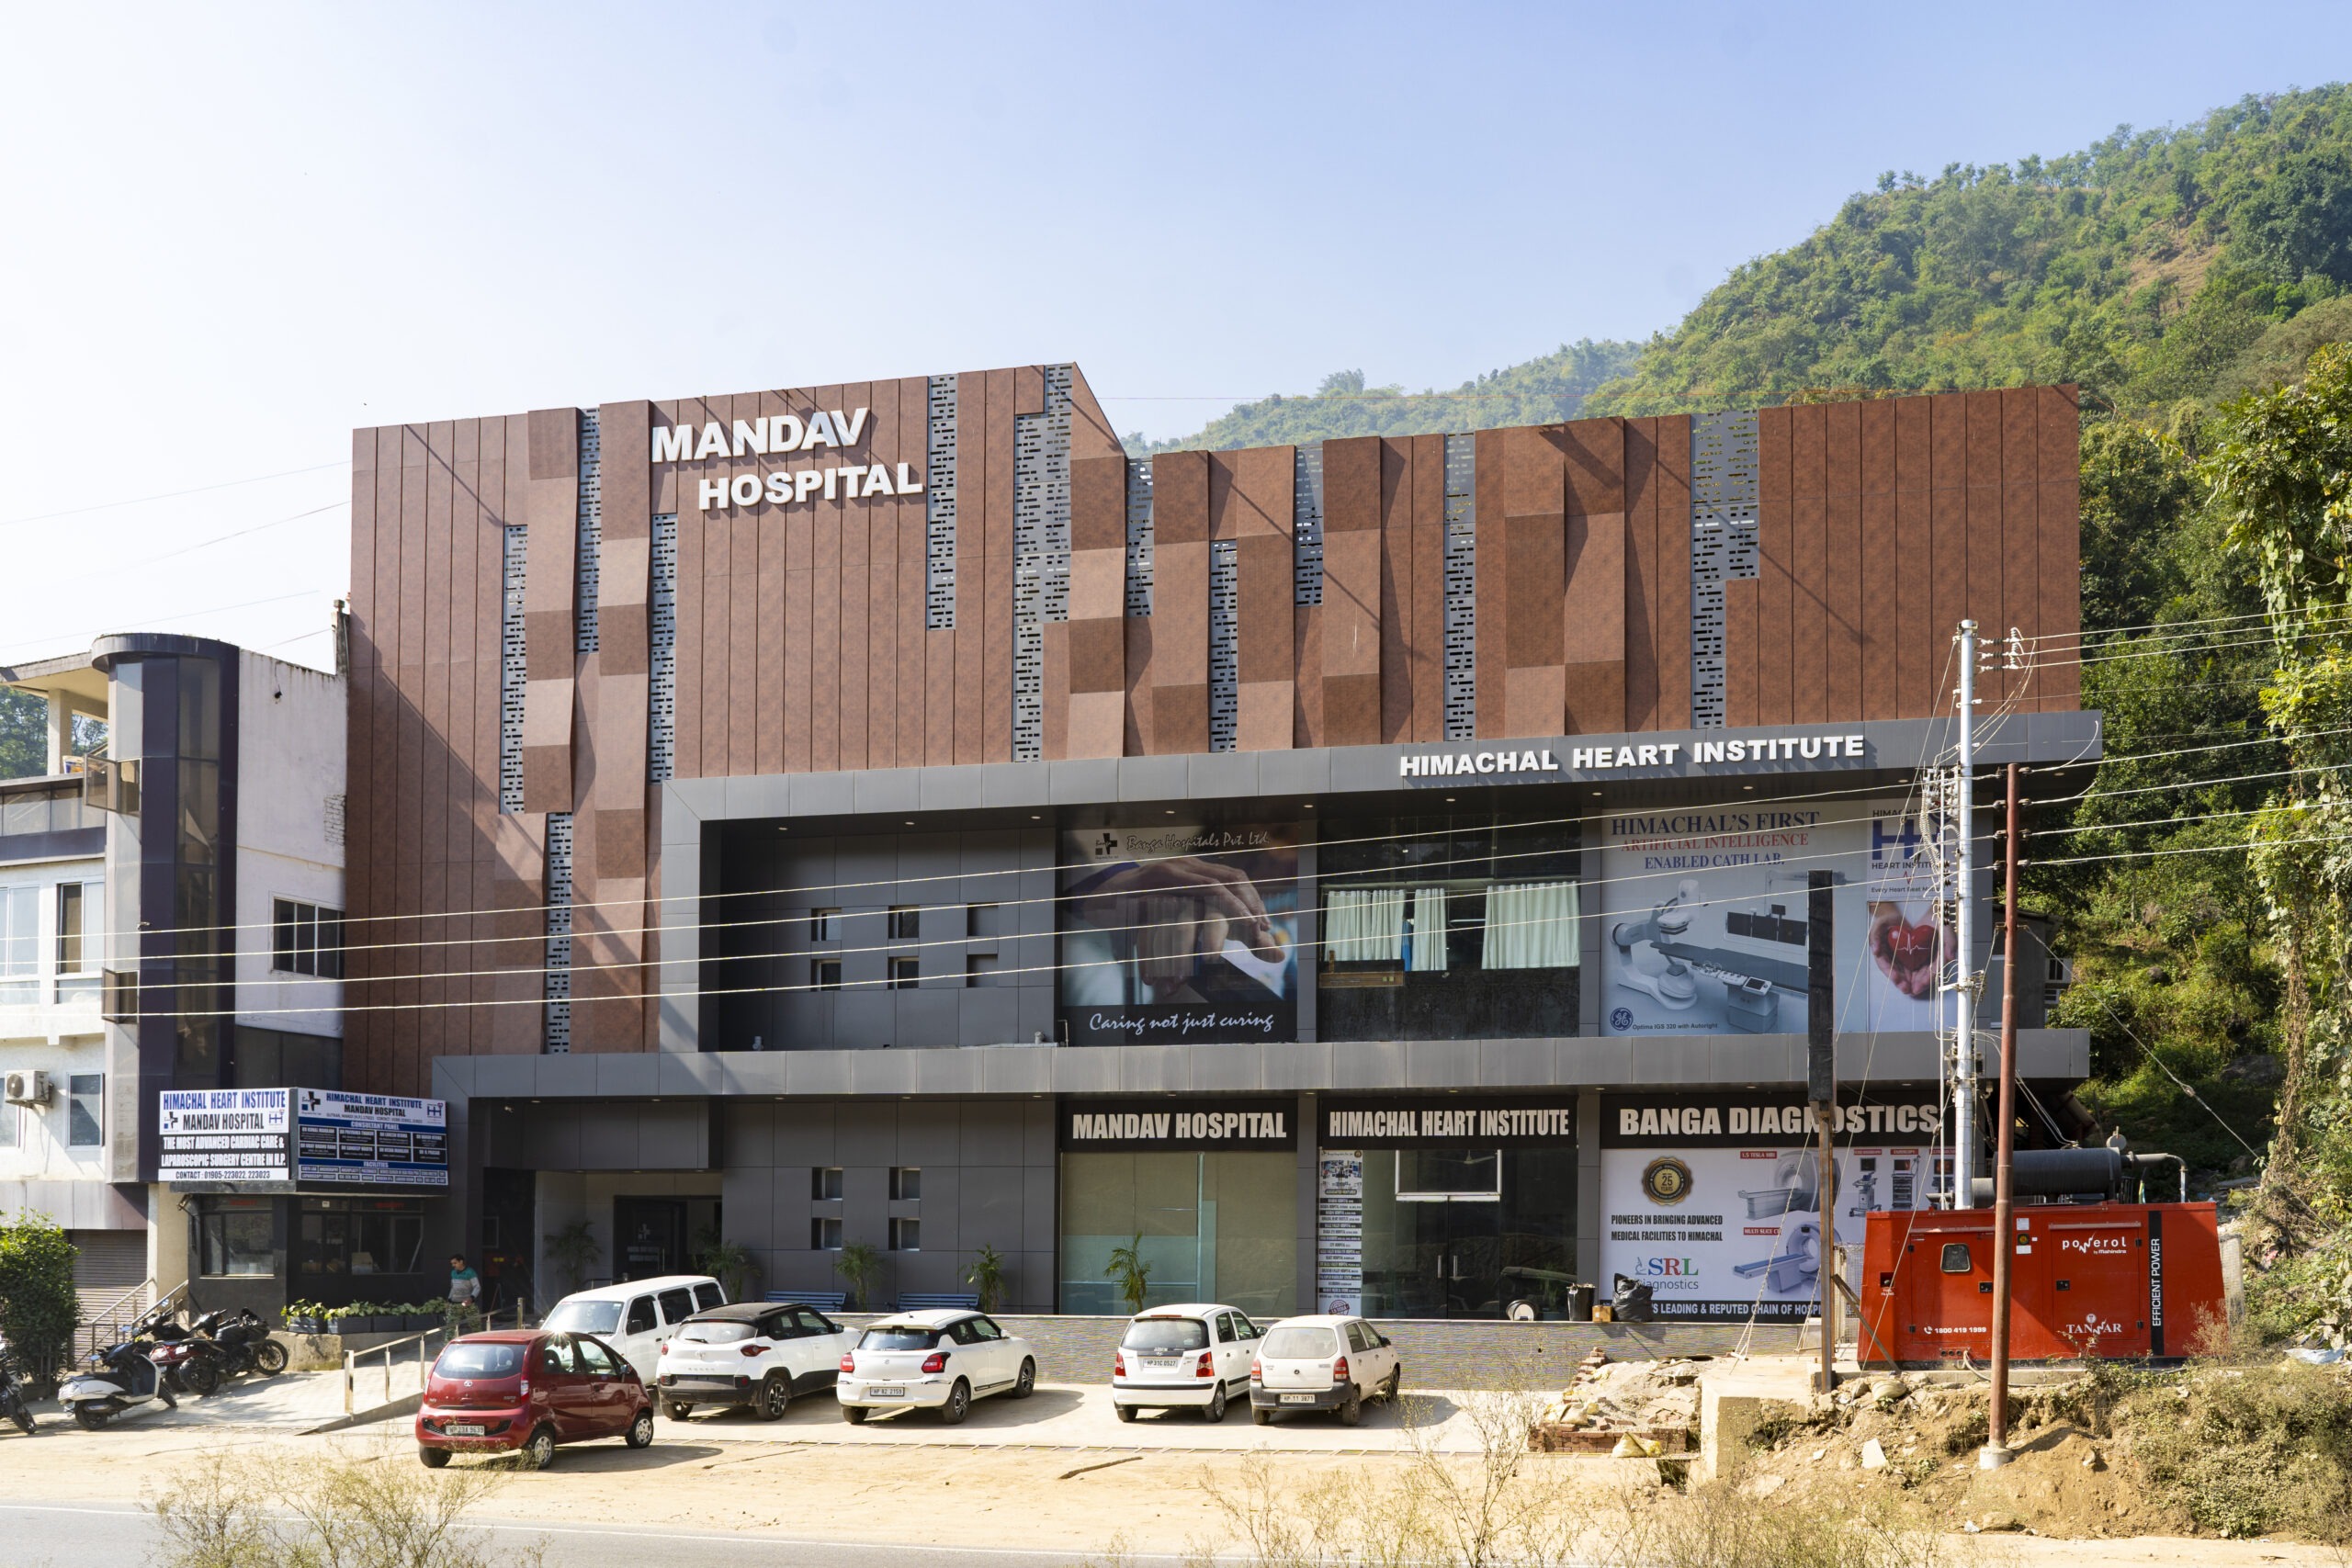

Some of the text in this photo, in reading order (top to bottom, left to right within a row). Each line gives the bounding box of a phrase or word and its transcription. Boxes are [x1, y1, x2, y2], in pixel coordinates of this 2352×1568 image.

[652, 407, 868, 463] MANDAV
[698, 462, 923, 511] HOSPITAL
[1400, 735, 1865, 777] HIMACHAL HEART INSTITUTE
[1757, 811, 1820, 830] FIRST
[1126, 835, 1163, 852] Banga
[1165, 831, 1219, 852] Hospitals
[1622, 833, 1809, 852] ARTIFICIAL INTELLIGENCE
[1645, 855, 1709, 869] ENABLED
[1713, 853, 1749, 867] CATH
[1090, 1012, 1274, 1035] Caring not just curing
[164, 1091, 285, 1110] HIMACHAL HEART INSTITUTE
[326, 1093, 422, 1109] HIMACHAL HEART INSTITUTE
[345, 1104, 373, 1114] MANDAV
[375, 1107, 405, 1117] HOSPITAL
[183, 1113, 220, 1130] MANDAV
[222, 1113, 264, 1130] HOSPITAL
[1072, 1112, 1286, 1139] MANDAV HOSPITAL
[1329, 1110, 1569, 1136] HIMACHAL HEART INSTITUTE
[1620, 1107, 1722, 1135] BANGA
[164, 1135, 284, 1149] THE MOST ADVANCED CARDIAC CARE &
[162, 1154, 209, 1167] LAPAROSCOPIC
[210, 1154, 240, 1166] SURGERY
[241, 1154, 266, 1166] CENTRE
[266, 1154, 274, 1166] IN
[1662, 1175, 1673, 1186] 25
[1611, 1214, 1723, 1224] PIONEERS IN BRINGING ADVANCED
[1611, 1231, 1723, 1241] MEDICAL FACILITIES TO HIMACHAL
[1648, 1258, 1699, 1276] SRL
[1641, 1278, 1699, 1292] iagnostics
[2151, 1238, 2161, 1325] EFFICIENT POWER
[1661, 1303, 1698, 1314] LEADING
[1701, 1304, 1706, 1314] &
[1709, 1303, 1748, 1314] REPUTED
[1751, 1303, 1779, 1314] CHAIN
[1781, 1303, 1792, 1314] OF
